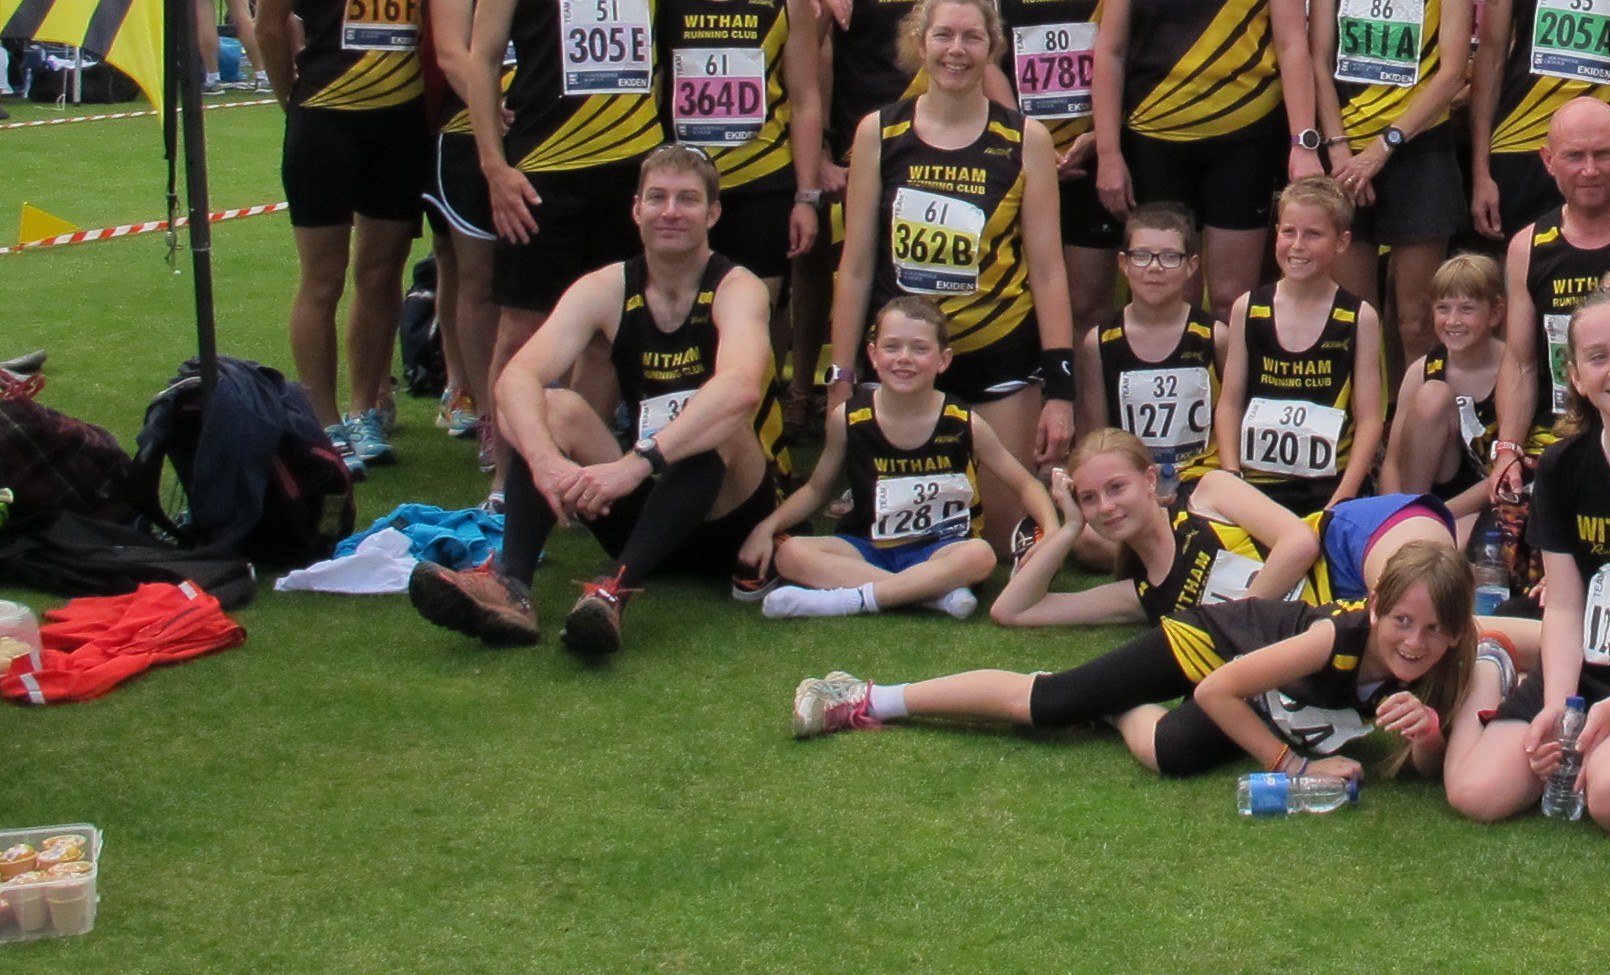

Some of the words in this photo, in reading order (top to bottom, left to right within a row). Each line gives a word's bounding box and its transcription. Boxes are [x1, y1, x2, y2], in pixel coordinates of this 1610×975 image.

[596, 0, 619, 22] 51
[684, 14, 759, 29] WITHAM
[683, 30, 729, 40] RUNNING
[730, 30, 759, 40] CLUB
[1044, 30, 1070, 51] 80
[705, 54, 728, 76] 61
[618, 78, 647, 88] EKIDEN
[678, 80, 760, 116] 364D
[908, 165, 986, 183] WITHAM
[955, 183, 986, 195] CLUB
[924, 202, 950, 226] 61
[894, 224, 974, 267] 362B
[936, 280, 974, 291] EKIDEN
[1263, 357, 1332, 375] WITHAM
[1152, 374, 1179, 398] 32
[1260, 374, 1303, 389] RUNNING
[1304, 374, 1332, 387] CLUB
[1278, 406, 1307, 427] 30
[874, 454, 952, 473] WITHAM
[912, 482, 939, 505] 32
[1592, 571, 1606, 599] TEAM
